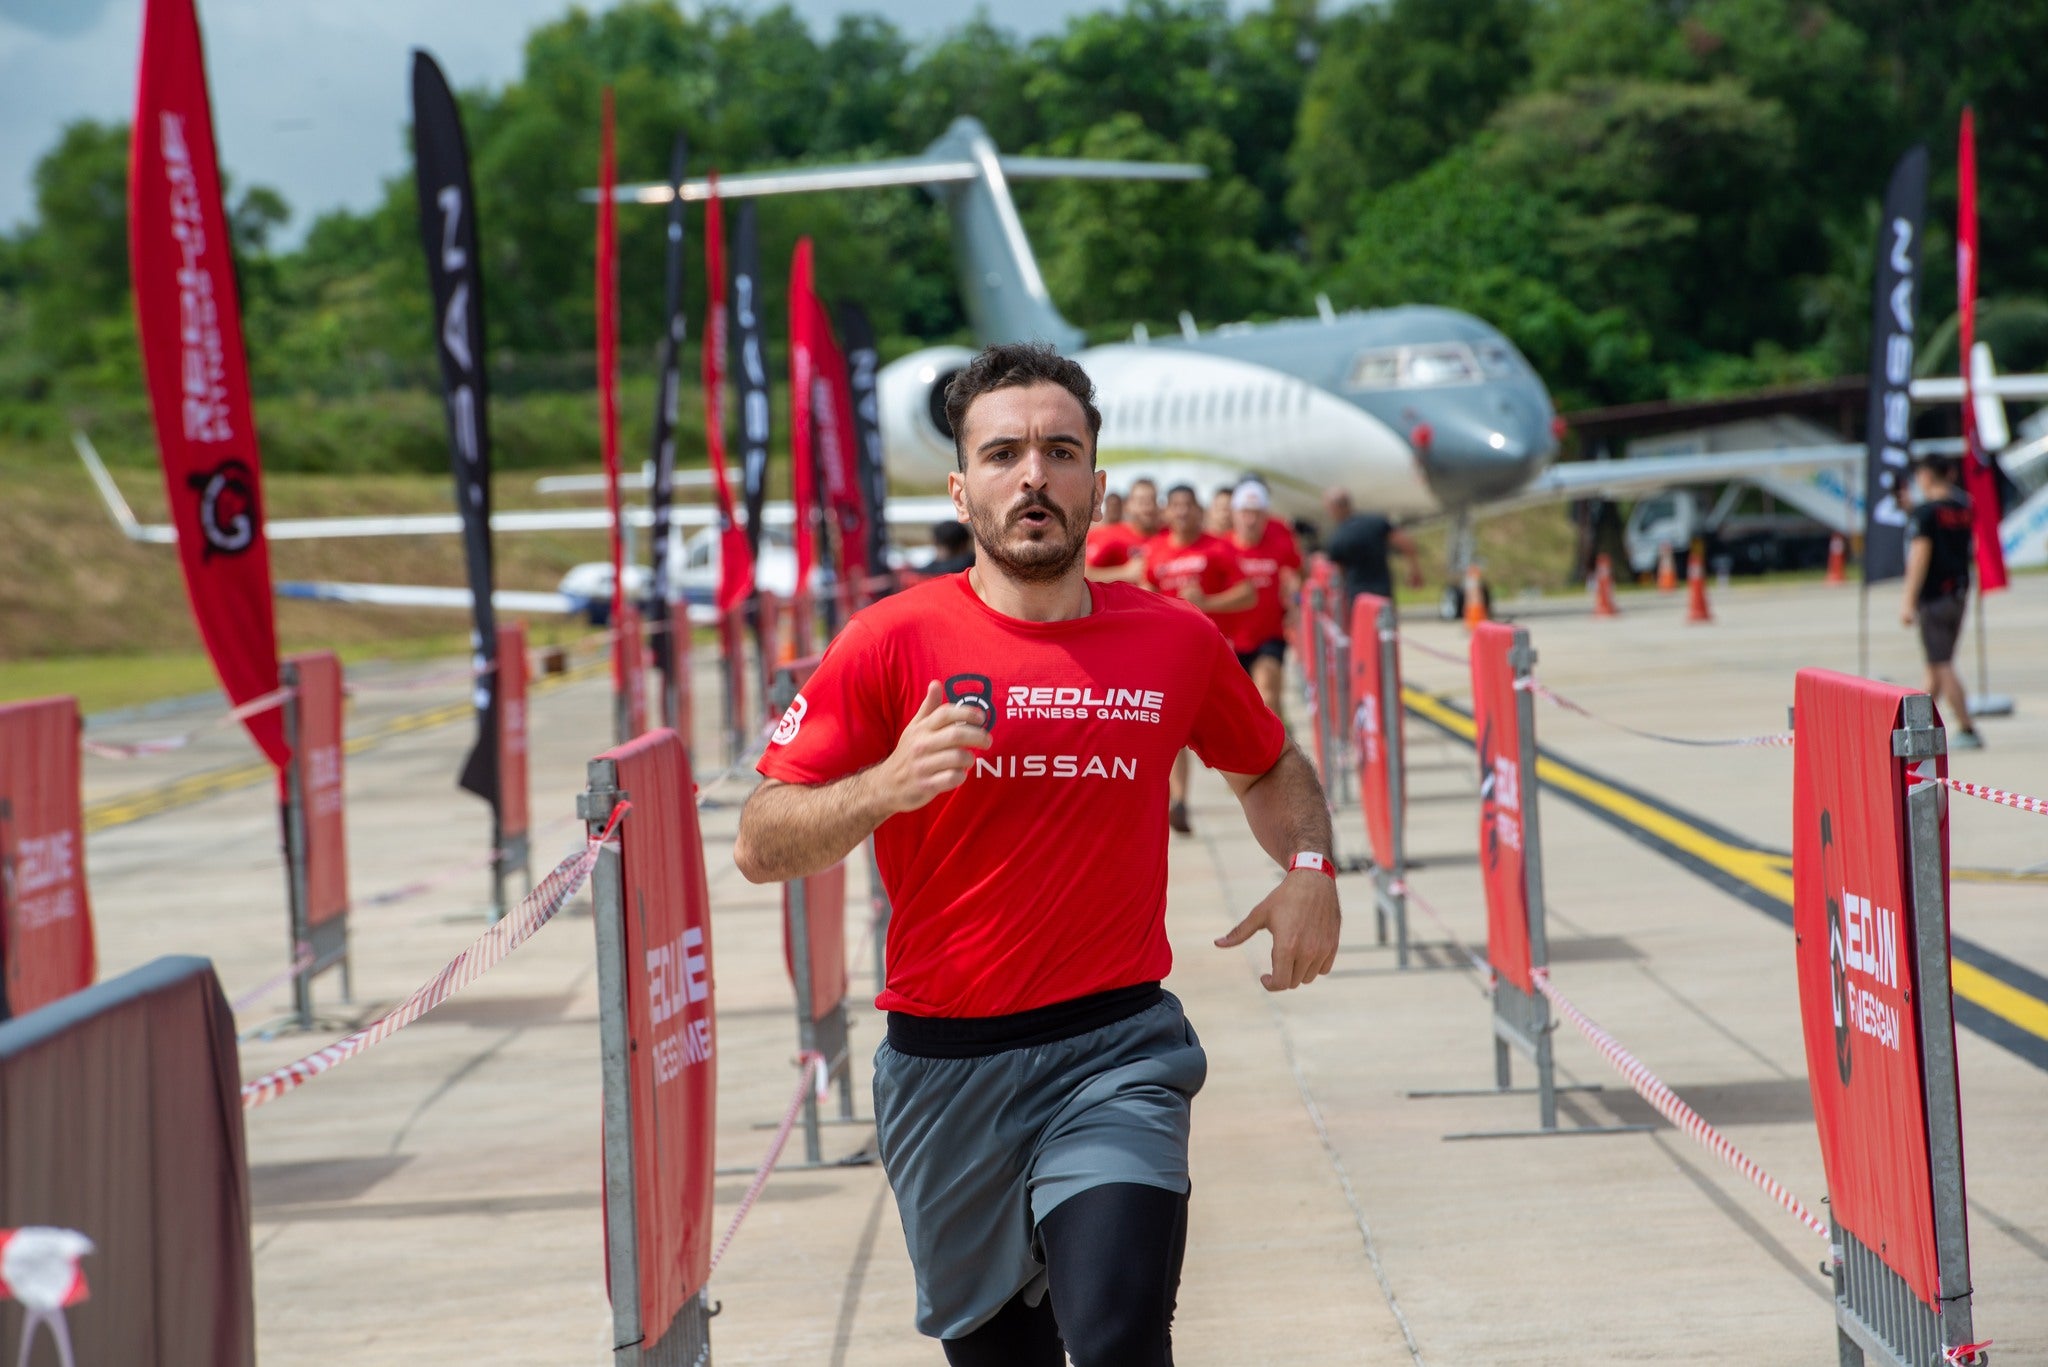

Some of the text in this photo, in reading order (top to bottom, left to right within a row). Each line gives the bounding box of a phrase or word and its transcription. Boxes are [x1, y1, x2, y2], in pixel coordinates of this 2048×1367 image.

[1006, 686, 1165, 710] REDLINE
[1006, 707, 1161, 724] FITNESS GAMES
[976, 755, 1138, 780] NISSAN
